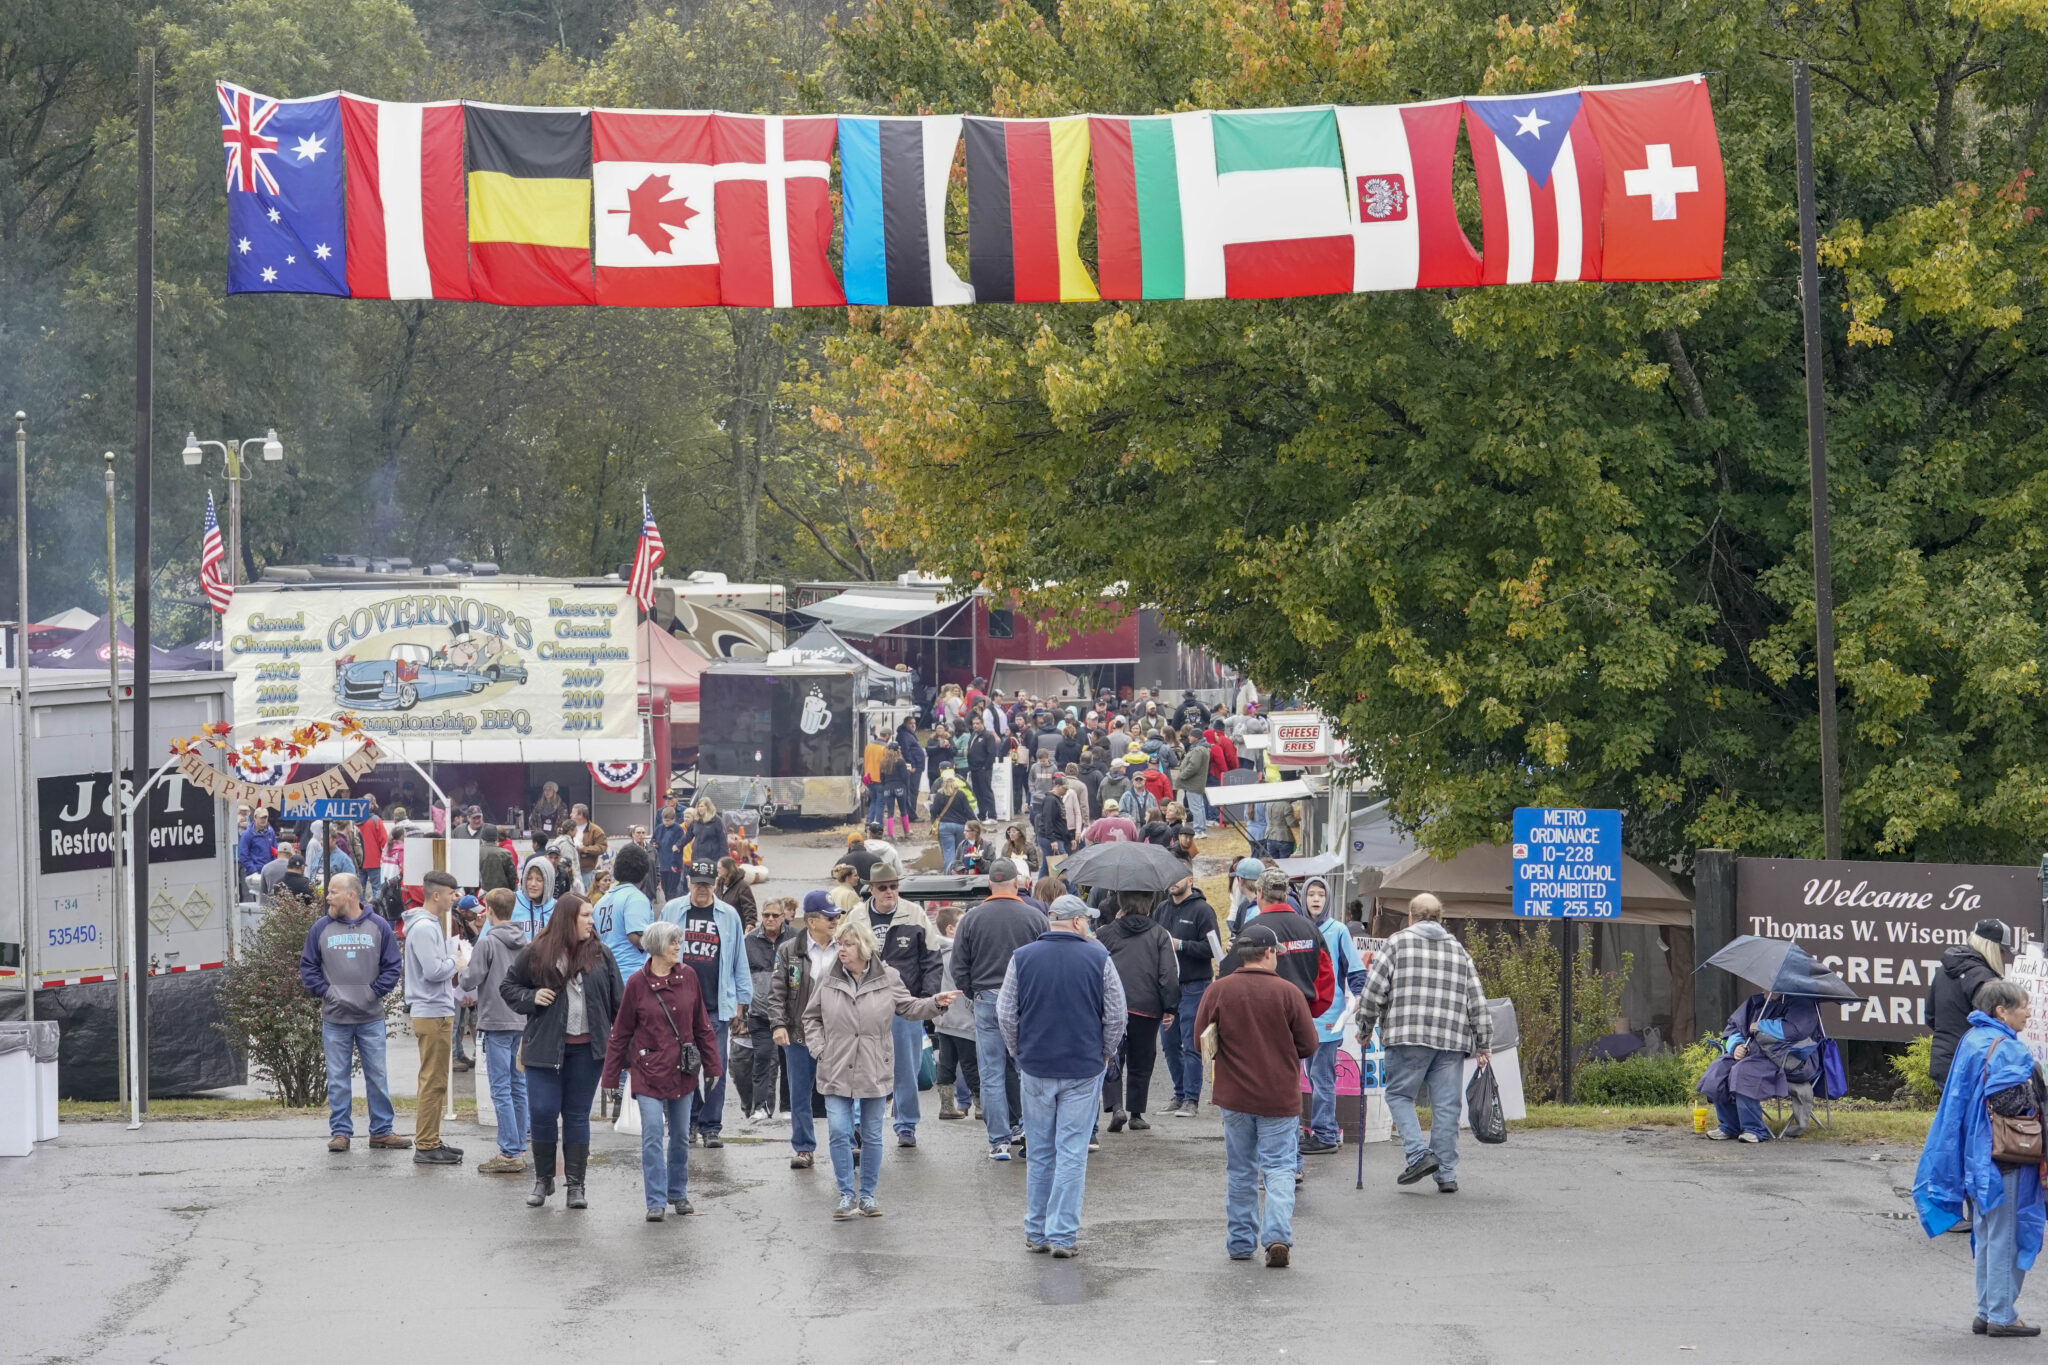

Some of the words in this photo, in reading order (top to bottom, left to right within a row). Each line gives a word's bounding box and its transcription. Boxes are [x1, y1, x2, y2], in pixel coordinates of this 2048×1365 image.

[548, 597, 617, 617] Reserve
[248, 611, 305, 632] Grand
[327, 594, 533, 651] GOVERNOR'S
[554, 619, 612, 639] Grand
[230, 635, 323, 658] Champion
[537, 641, 629, 665] Champion
[255, 662, 301, 681] 2002
[561, 668, 605, 687] 2009
[256, 684, 298, 703] 2006
[562, 690, 605, 709] 2010
[256, 706, 299, 726] 2007
[330, 710, 477, 735] Campionship
[480, 708, 533, 735] BBQ
[562, 712, 604, 731] 2011
[1278, 726, 1320, 739] CHEESE
[1283, 741, 1315, 752] FRIES
[183, 756, 280, 804] HAPPY
[308, 747, 379, 797] FALL
[59, 781, 96, 822] J
[157, 773, 188, 813] T
[284, 802, 316, 818] PARK
[325, 802, 368, 818] ALLEY
[1544, 810, 1586, 825] METRO
[150, 819, 204, 848] ervice
[1530, 828, 1600, 844] ORDINANCE
[1542, 846, 1594, 862] 10-228
[1520, 864, 1554, 880] OPEN
[1558, 864, 1616, 881] ALCOHOL
[1530, 883, 1606, 898] PROHIBITED
[1803, 878, 1932, 909] Welcome
[1940, 883, 1982, 911] To
[54, 898, 78, 912] T-34
[1524, 900, 1552, 916] FINE
[1563, 901, 1612, 917] 255.50
[49, 925, 96, 946] 535450
[1750, 916, 1844, 940] Thomas
[1851, 920, 1879, 942] W.
[1886, 921, 1968, 945] Wisem
[1288, 939, 1313, 950] NASCAR
